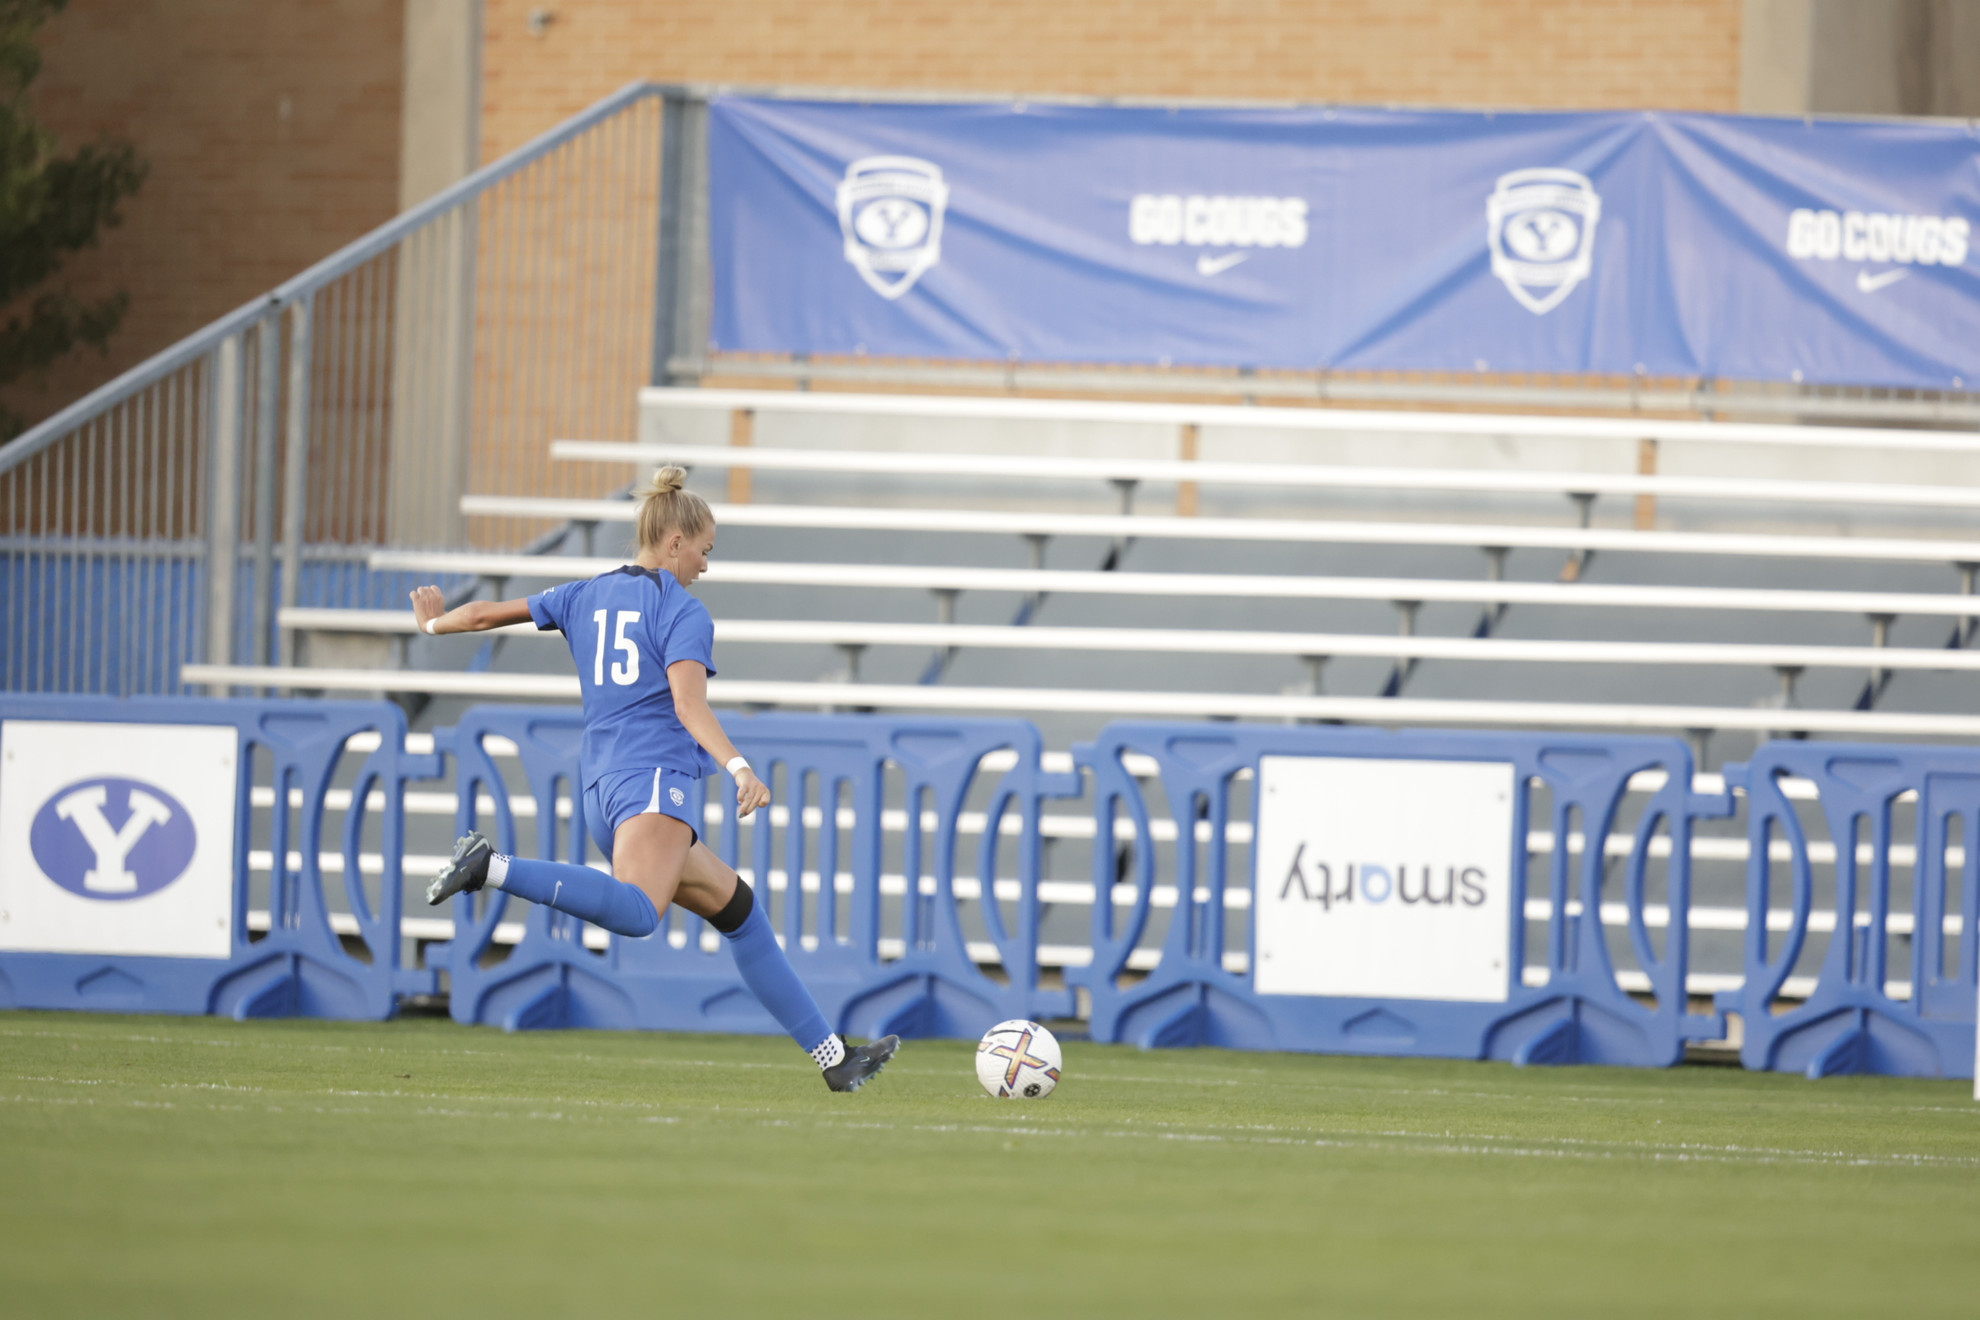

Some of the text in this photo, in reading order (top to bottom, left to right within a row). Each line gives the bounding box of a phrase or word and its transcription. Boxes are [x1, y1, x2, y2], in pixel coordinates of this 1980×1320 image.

[1130, 194, 1309, 248] GO COUGS
[1787, 208, 1970, 267] GO COUGS
[593, 609, 642, 686] 15
[55, 784, 173, 893] Y
[1279, 842, 1487, 912] smarty
